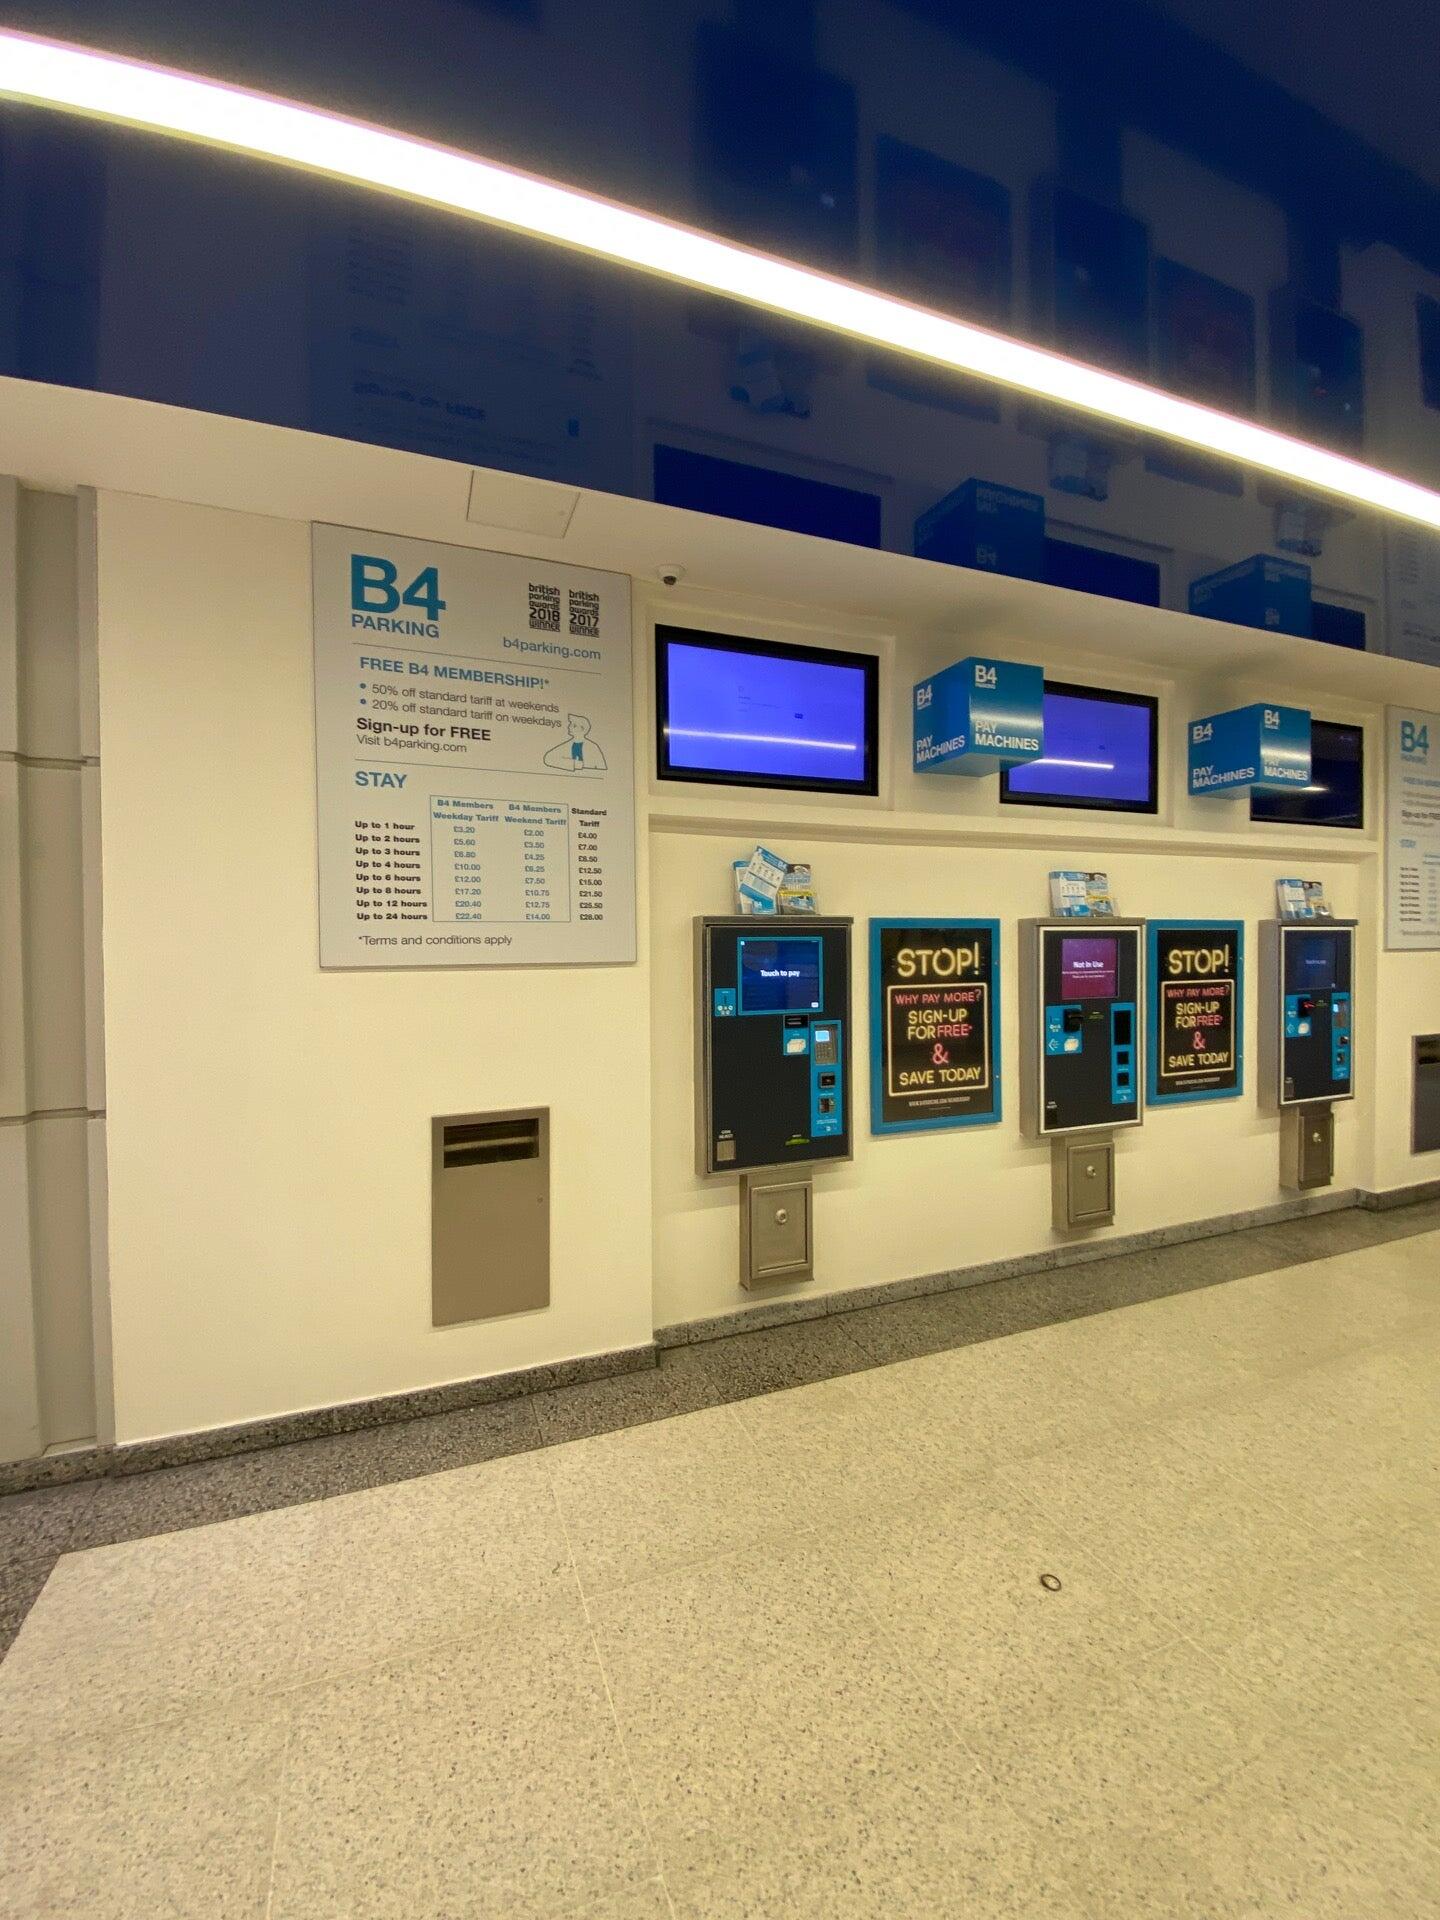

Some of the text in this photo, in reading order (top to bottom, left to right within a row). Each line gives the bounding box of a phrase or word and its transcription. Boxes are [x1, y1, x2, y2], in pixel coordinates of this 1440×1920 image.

[351, 554, 446, 621] B4
[529, 583, 560, 595] british
[569, 589, 599, 602] british
[529, 593, 560, 604] parking
[569, 599, 599, 610] parking
[530, 607, 560, 621] 2018
[570, 613, 599, 627] 2017
[351, 614, 439, 638] PARKING
[503, 637, 600, 660] b4parking.com
[360, 657, 403, 674] FREE
[409, 663, 429, 676] B4
[975, 665, 997, 684] B4
[372, 684, 559, 713] 50% off standard tariff at weekends
[917, 685, 933, 706] B4
[372, 700, 562, 728] 20% off standard tariff on weekdays
[1264, 710, 1279, 726] B4
[357, 718, 491, 741] Sign-up for FREE
[975, 720, 998, 734] PAY
[1193, 723, 1213, 741] B4
[356, 734, 467, 753] Visit b4parking.com
[917, 735, 933, 751] PAY
[975, 734, 1039, 751] MACHINES
[1401, 721, 1429, 755] B4
[917, 735, 965, 763] MACHINES
[1193, 765, 1214, 777] PAY
[1193, 767, 1255, 788] MACHINES
[1264, 766, 1308, 781] MACHINES
[355, 771, 407, 788] STAY
[453, 801, 494, 810] Members
[523, 805, 561, 813] Members
[572, 808, 607, 816] Standard
[355, 821, 368, 829] Up
[433, 812, 473, 822] Weekday
[505, 816, 567, 826] Weekend Tariff
[355, 834, 368, 842] Up
[356, 847, 369, 855] Up
[401, 936, 422, 945] and
[426, 935, 481, 944] conditions
[484, 935, 512, 946] apply
[897, 942, 979, 977] STOP!
[1169, 944, 1229, 974] STOP!
[895, 989, 981, 1005] WHY PAY MORE?
[1167, 985, 1230, 998] WHY PAY MORE?
[909, 1008, 967, 1024] SIGN-UP
[1176, 1001, 1220, 1015] SIGN-UP
[1175, 1016, 1196, 1029] FOR
[908, 1026, 936, 1040] FOR
[1192, 1031, 1205, 1050] &
[932, 1043, 949, 1065] &
[1169, 1052, 1229, 1068] SAVE TODAY
[900, 1067, 981, 1086] SAVE TODAY
